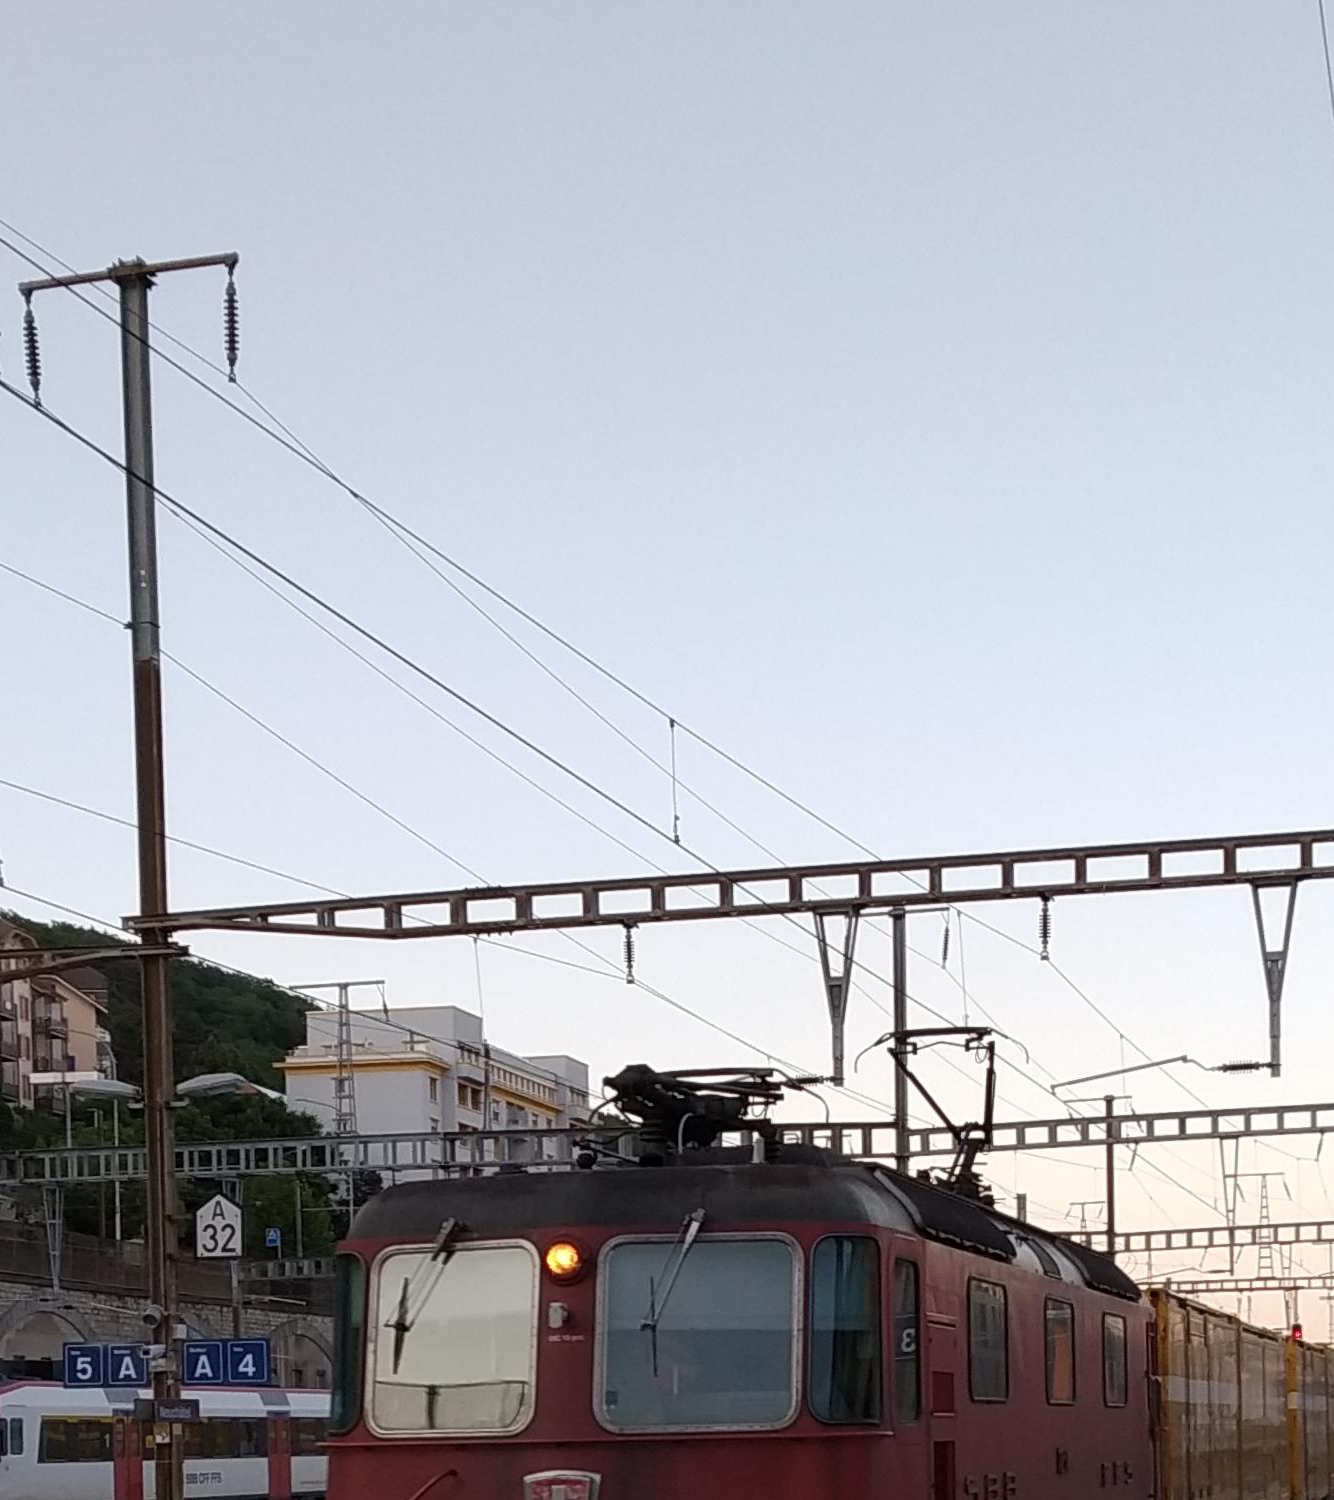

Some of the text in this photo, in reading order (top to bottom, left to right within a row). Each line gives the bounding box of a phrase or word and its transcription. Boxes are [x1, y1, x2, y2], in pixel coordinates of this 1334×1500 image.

[211, 1200, 226, 1221] A
[202, 1223, 236, 1253] 32
[76, 1356, 137, 1380] 5 A
[194, 1353, 257, 1378] A 4
[104, 1433, 110, 1448] 1
